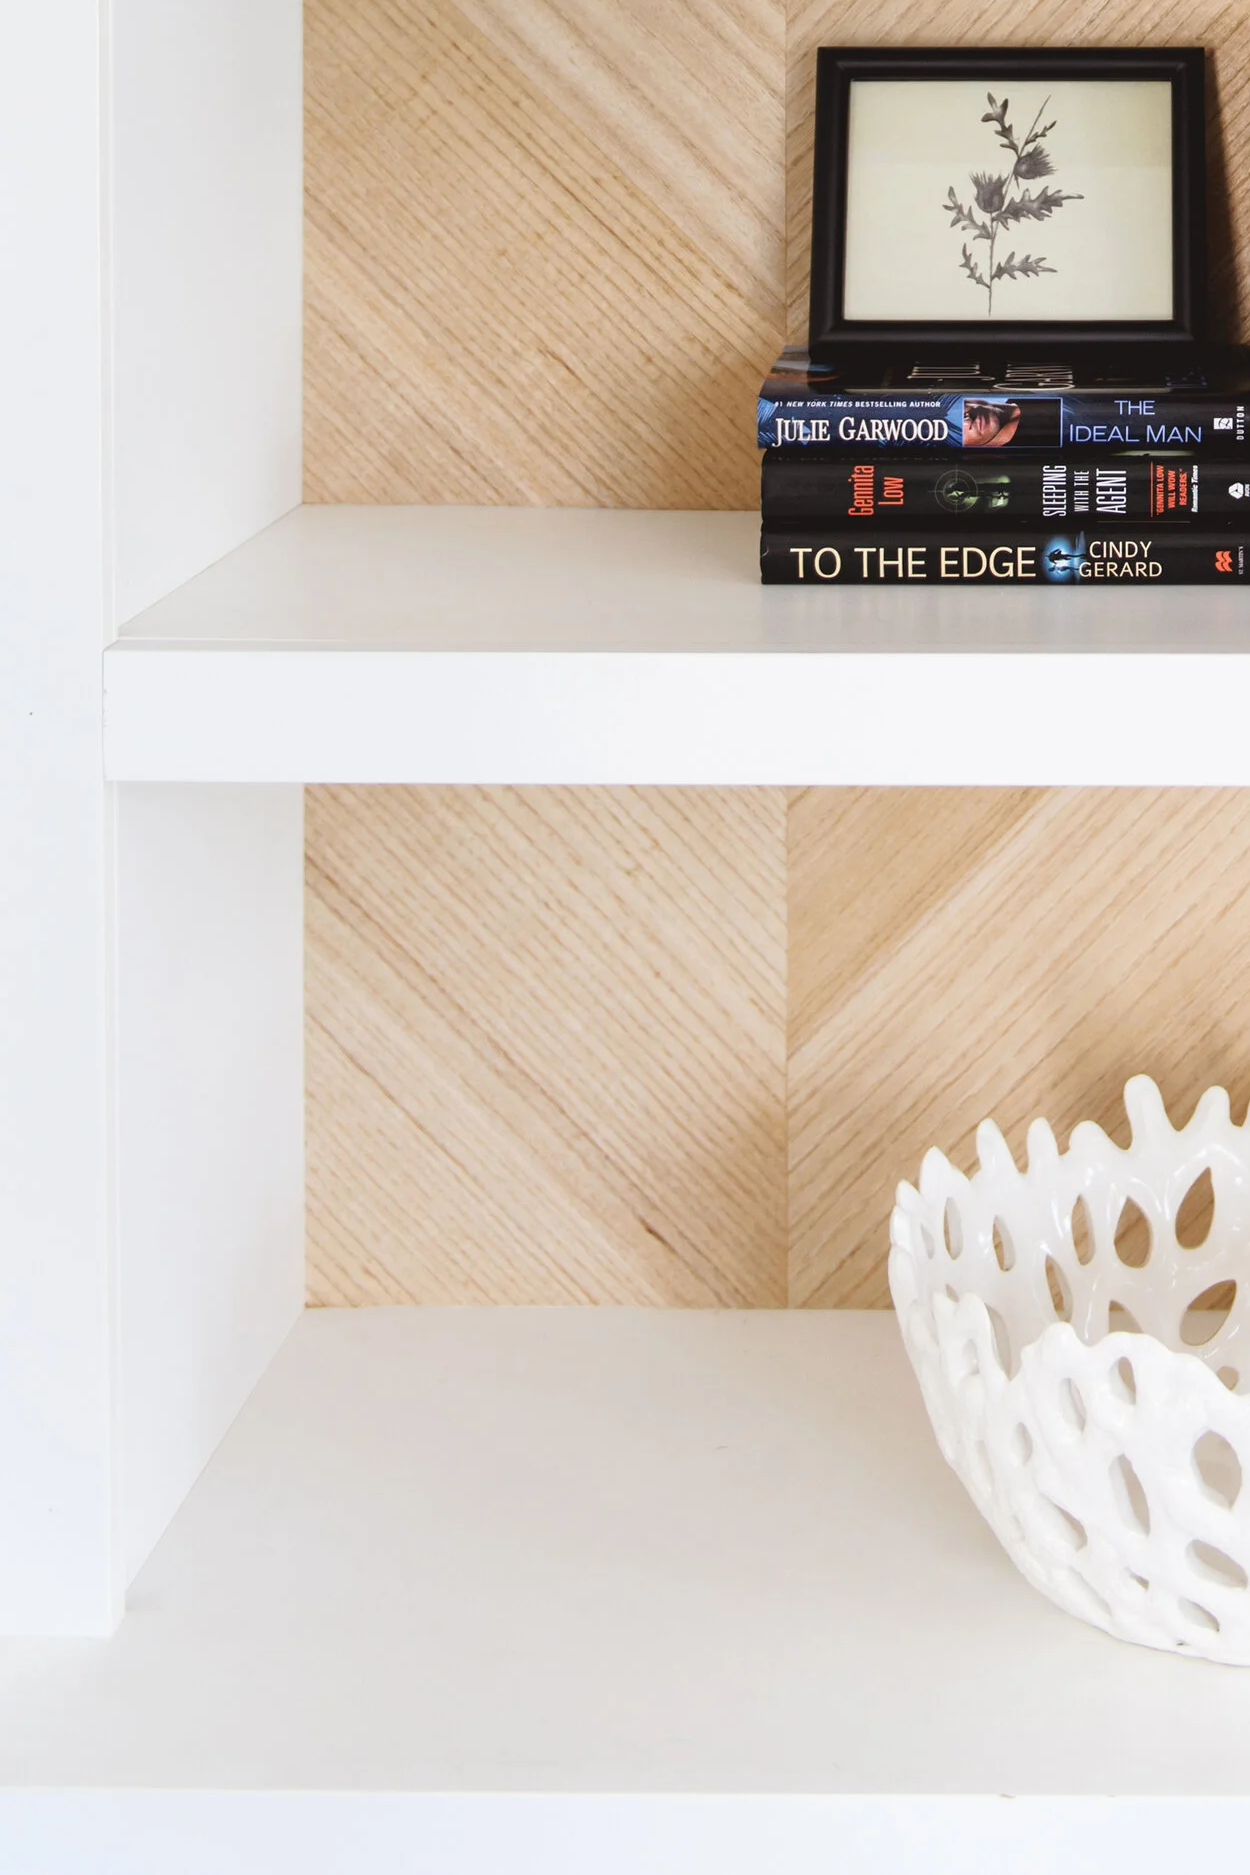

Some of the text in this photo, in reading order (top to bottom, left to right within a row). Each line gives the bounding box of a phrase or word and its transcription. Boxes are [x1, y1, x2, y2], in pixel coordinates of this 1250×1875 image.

[1114, 400, 1156, 415] THE
[1236, 405, 1245, 441] DUTTON
[772, 416, 948, 447] JULIE GARWOOD
[1069, 424, 1202, 443] IDEAL MAN
[1156, 465, 1165, 481] LOW
[1191, 465, 1199, 513] Romantic Times
[848, 464, 875, 516] Gennita
[878, 476, 904, 506] Low
[1042, 465, 1067, 517] SLEEPING
[1073, 470, 1090, 513] WITH THE
[1096, 468, 1127, 514] AGENT
[1167, 470, 1176, 509] WILL WOW
[790, 547, 1037, 579] TO THE EDGE
[1089, 541, 1152, 559] CINDY
[1079, 561, 1163, 578] GERARD
